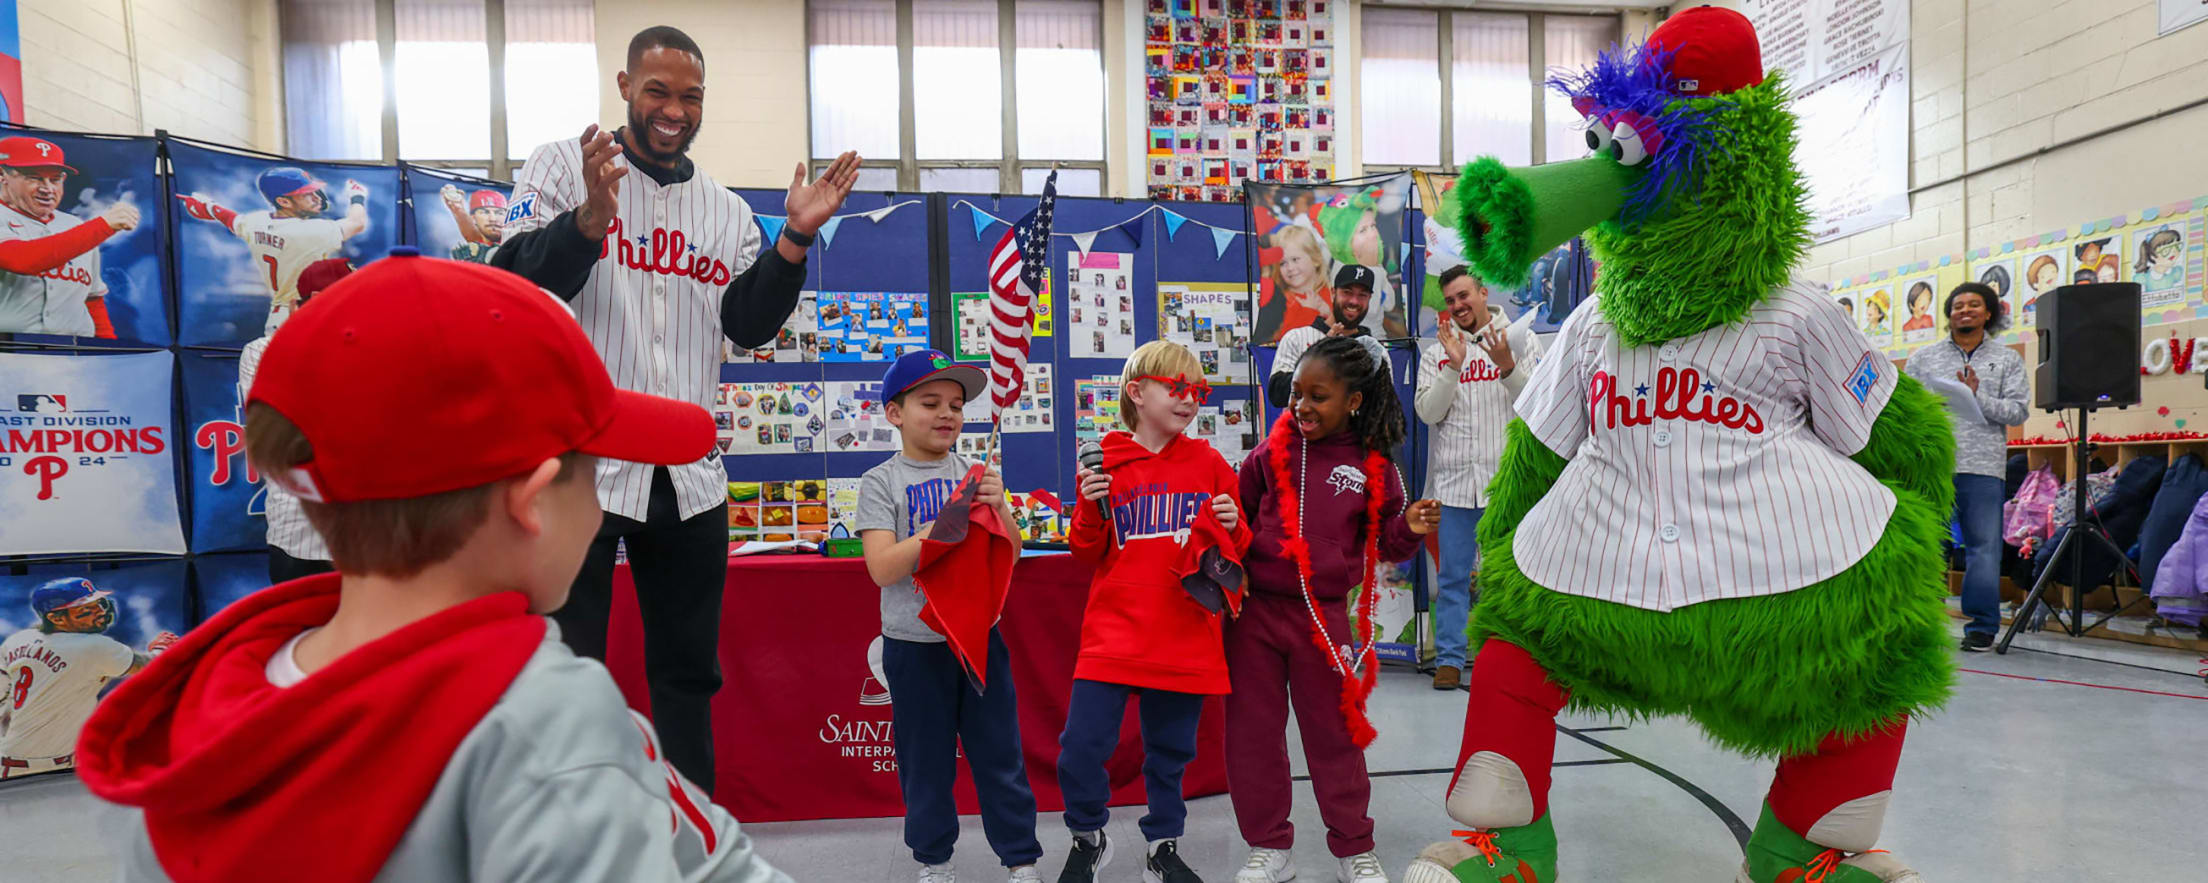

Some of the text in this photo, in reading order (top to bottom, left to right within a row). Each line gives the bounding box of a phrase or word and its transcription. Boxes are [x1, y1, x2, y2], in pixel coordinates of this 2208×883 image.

[504, 199, 533, 224] IBX
[254, 231, 285, 249] TURNER
[263, 254, 279, 291] 7
[1183, 293, 1232, 305] SHAPES
[1852, 362, 1877, 403] IBX
[1588, 366, 1764, 437] Phillies
[43, 416, 131, 426] DIVISION
[79, 457, 106, 466] 24
[24, 456, 69, 500] P
[14, 665, 34, 711] 8
[819, 713, 894, 744] SAINT
